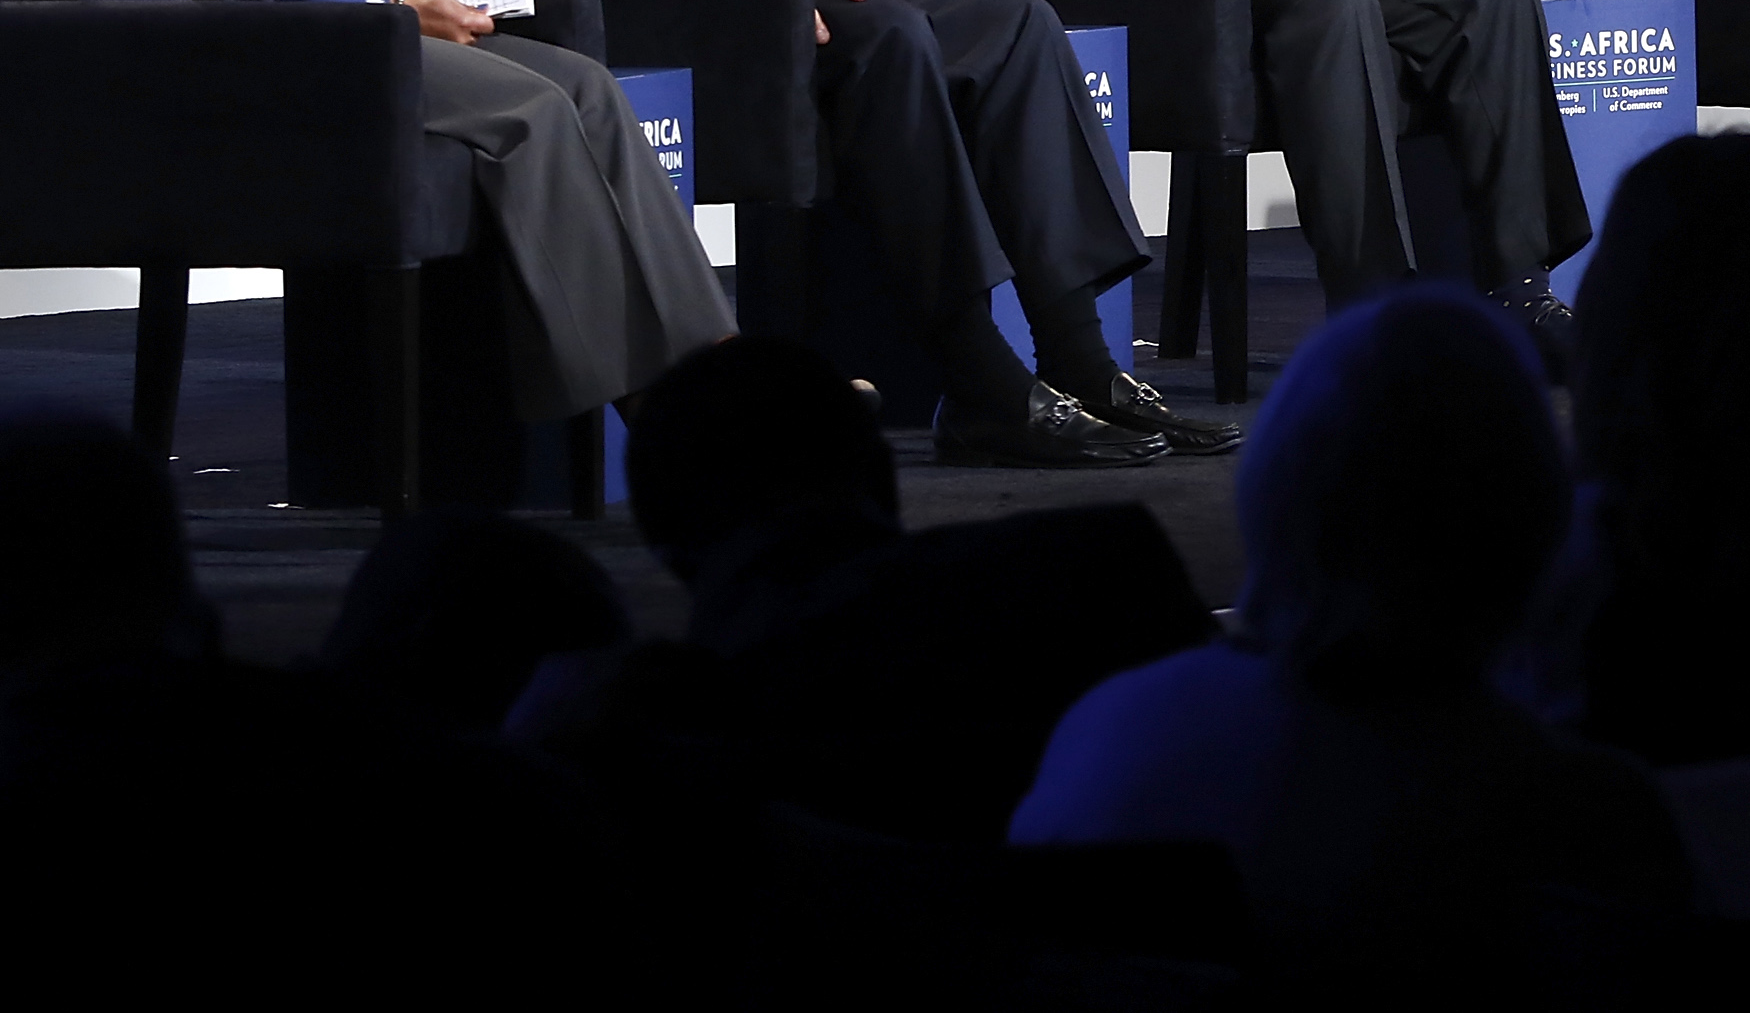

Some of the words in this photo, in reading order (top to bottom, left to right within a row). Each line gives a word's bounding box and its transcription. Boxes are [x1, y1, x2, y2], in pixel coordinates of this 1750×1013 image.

[1579, 27, 1675, 57] AFRICA
[1613, 56, 1676, 76] FORUM
[1622, 85, 1669, 99] Department
[1609, 101, 1619, 112] of
[1620, 100, 1662, 111] Commerce
[639, 118, 682, 147] RICA
